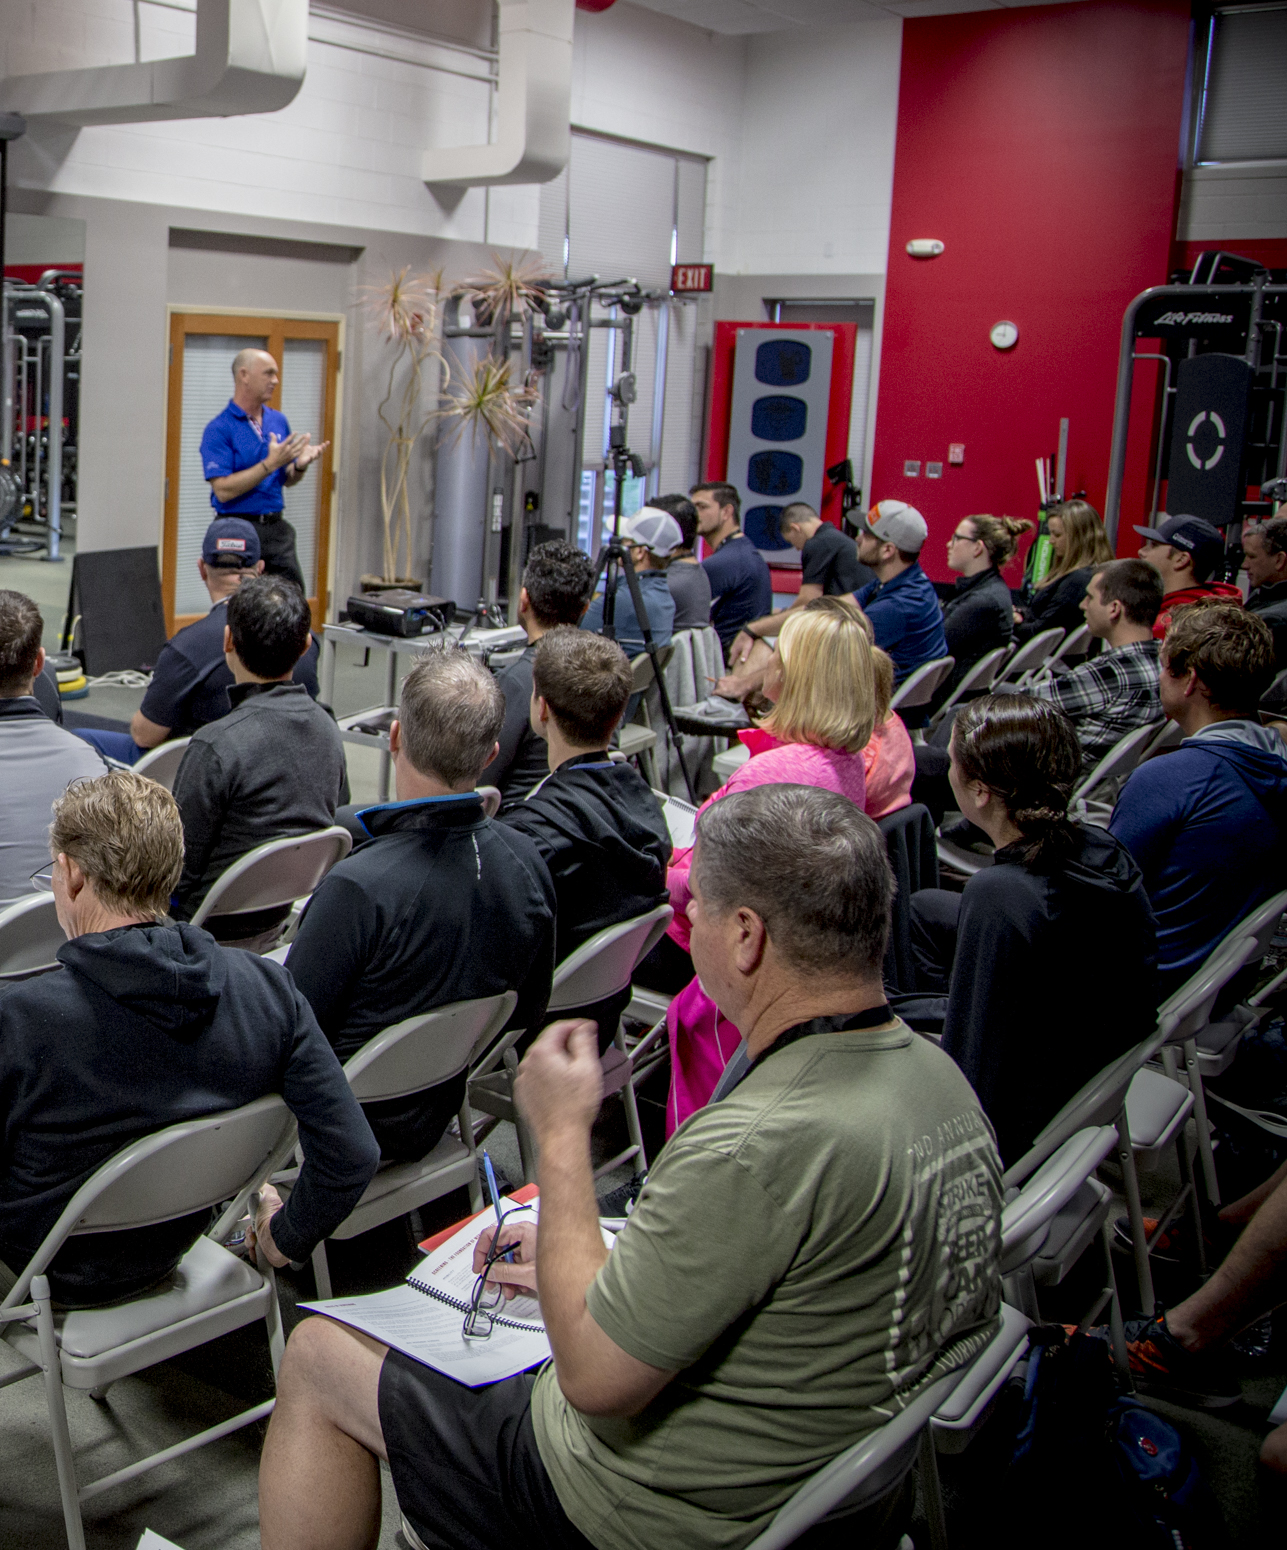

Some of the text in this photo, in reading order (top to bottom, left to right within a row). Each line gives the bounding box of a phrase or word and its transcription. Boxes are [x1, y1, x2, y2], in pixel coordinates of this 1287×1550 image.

[677, 267, 707, 289] EXIT
[907, 1109, 985, 1161] ND ANNUA
